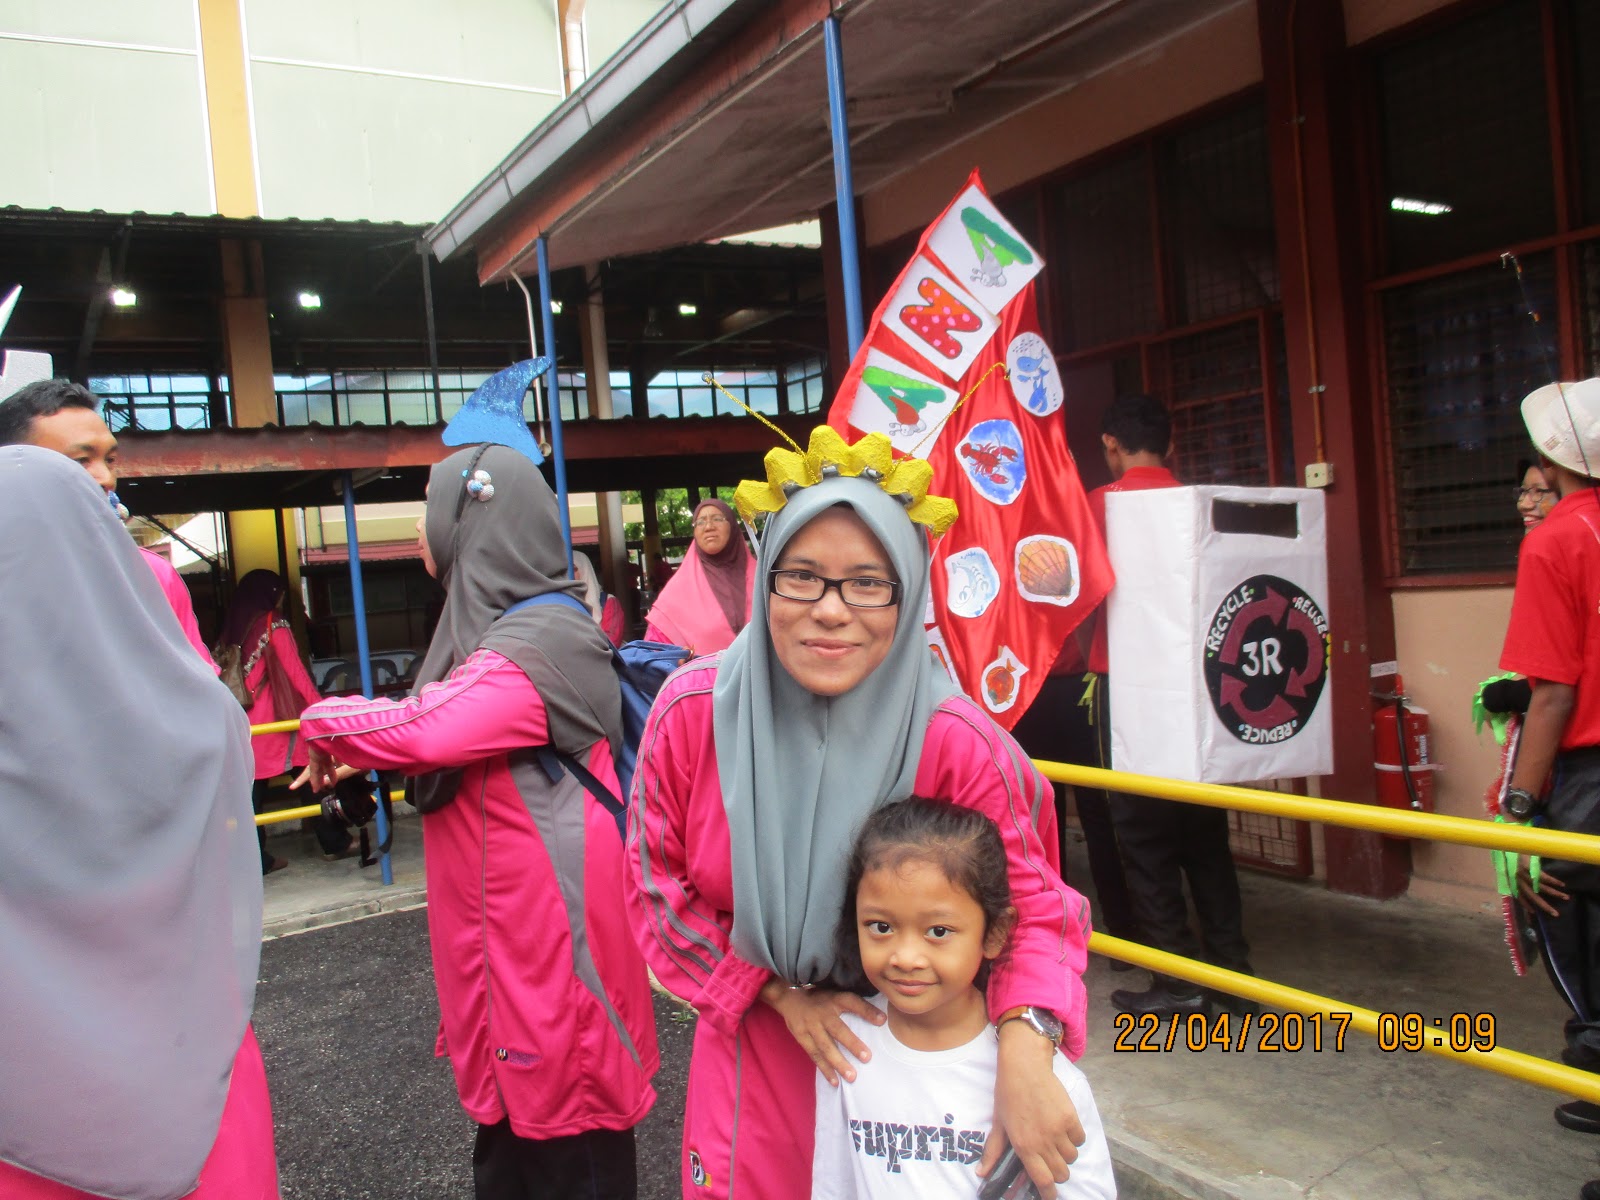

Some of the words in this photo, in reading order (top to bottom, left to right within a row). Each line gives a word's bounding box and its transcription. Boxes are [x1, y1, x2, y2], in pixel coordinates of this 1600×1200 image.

[1206, 585, 1252, 652] RECYCLE
[1294, 596, 1328, 635] REUSE
[1241, 637, 1284, 677] 3R
[1241, 722, 1294, 743] REDUCE
